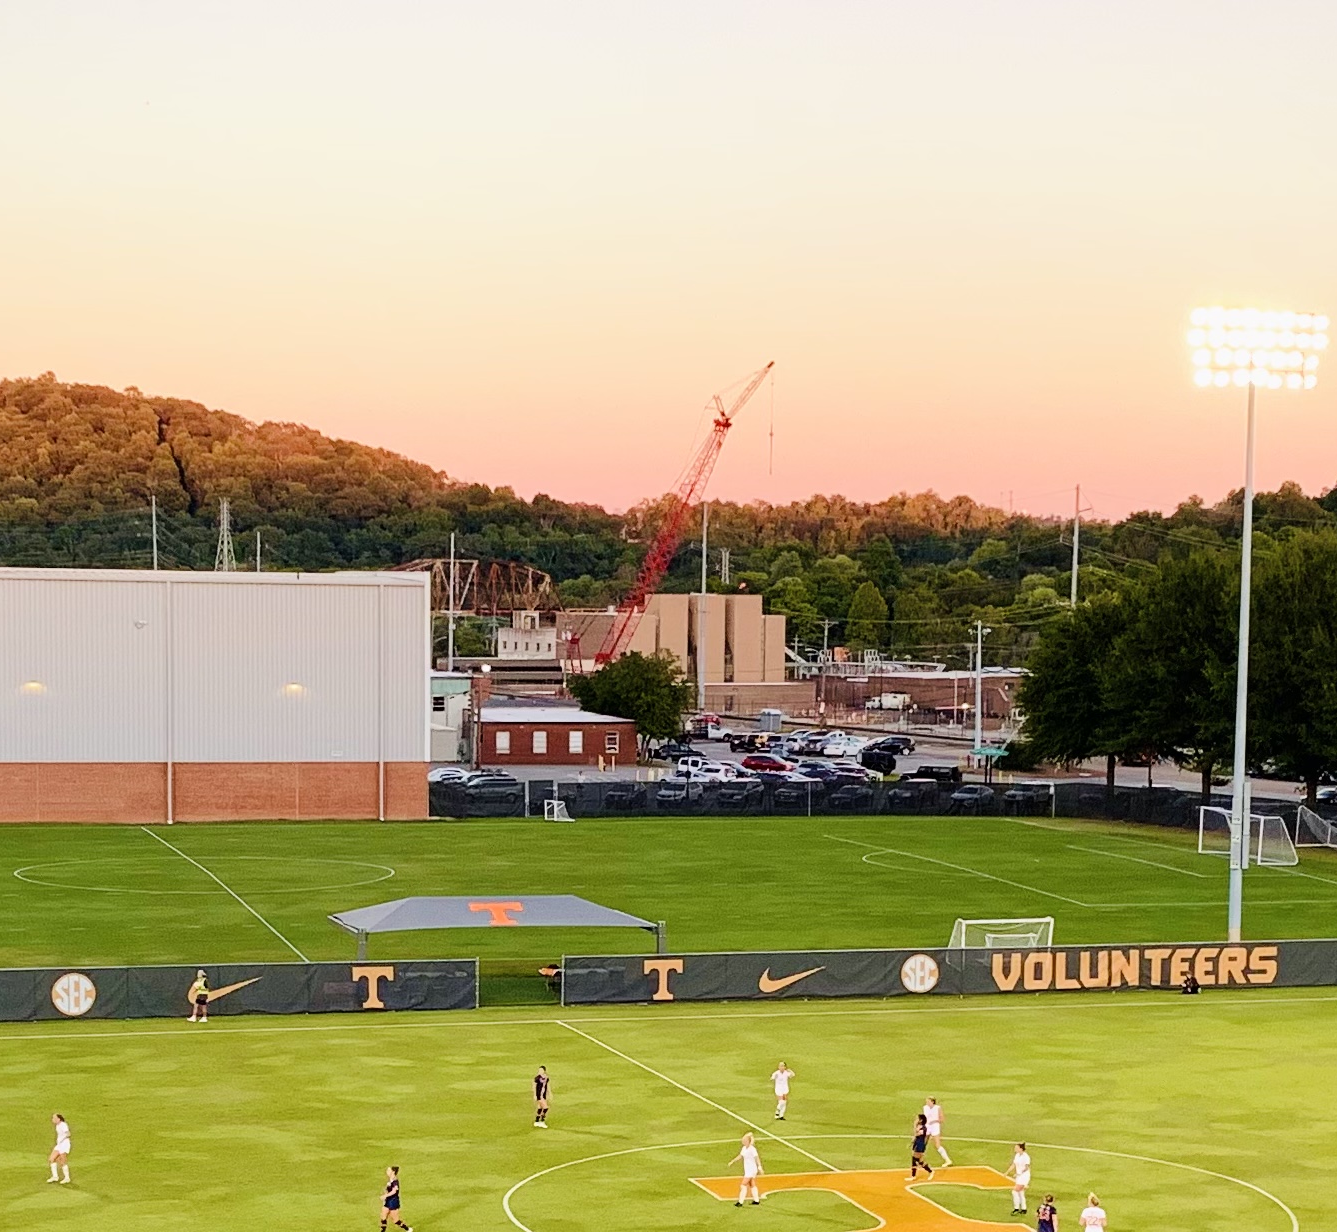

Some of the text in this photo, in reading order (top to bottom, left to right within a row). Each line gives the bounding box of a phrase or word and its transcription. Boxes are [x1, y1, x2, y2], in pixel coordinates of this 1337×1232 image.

[468, 901, 524, 926] T
[352, 966, 394, 1009] T
[644, 960, 683, 1000] T
[902, 955, 938, 992] SEC
[992, 946, 1278, 991] VOLUNTEERS
[54, 975, 94, 1014] SEC
